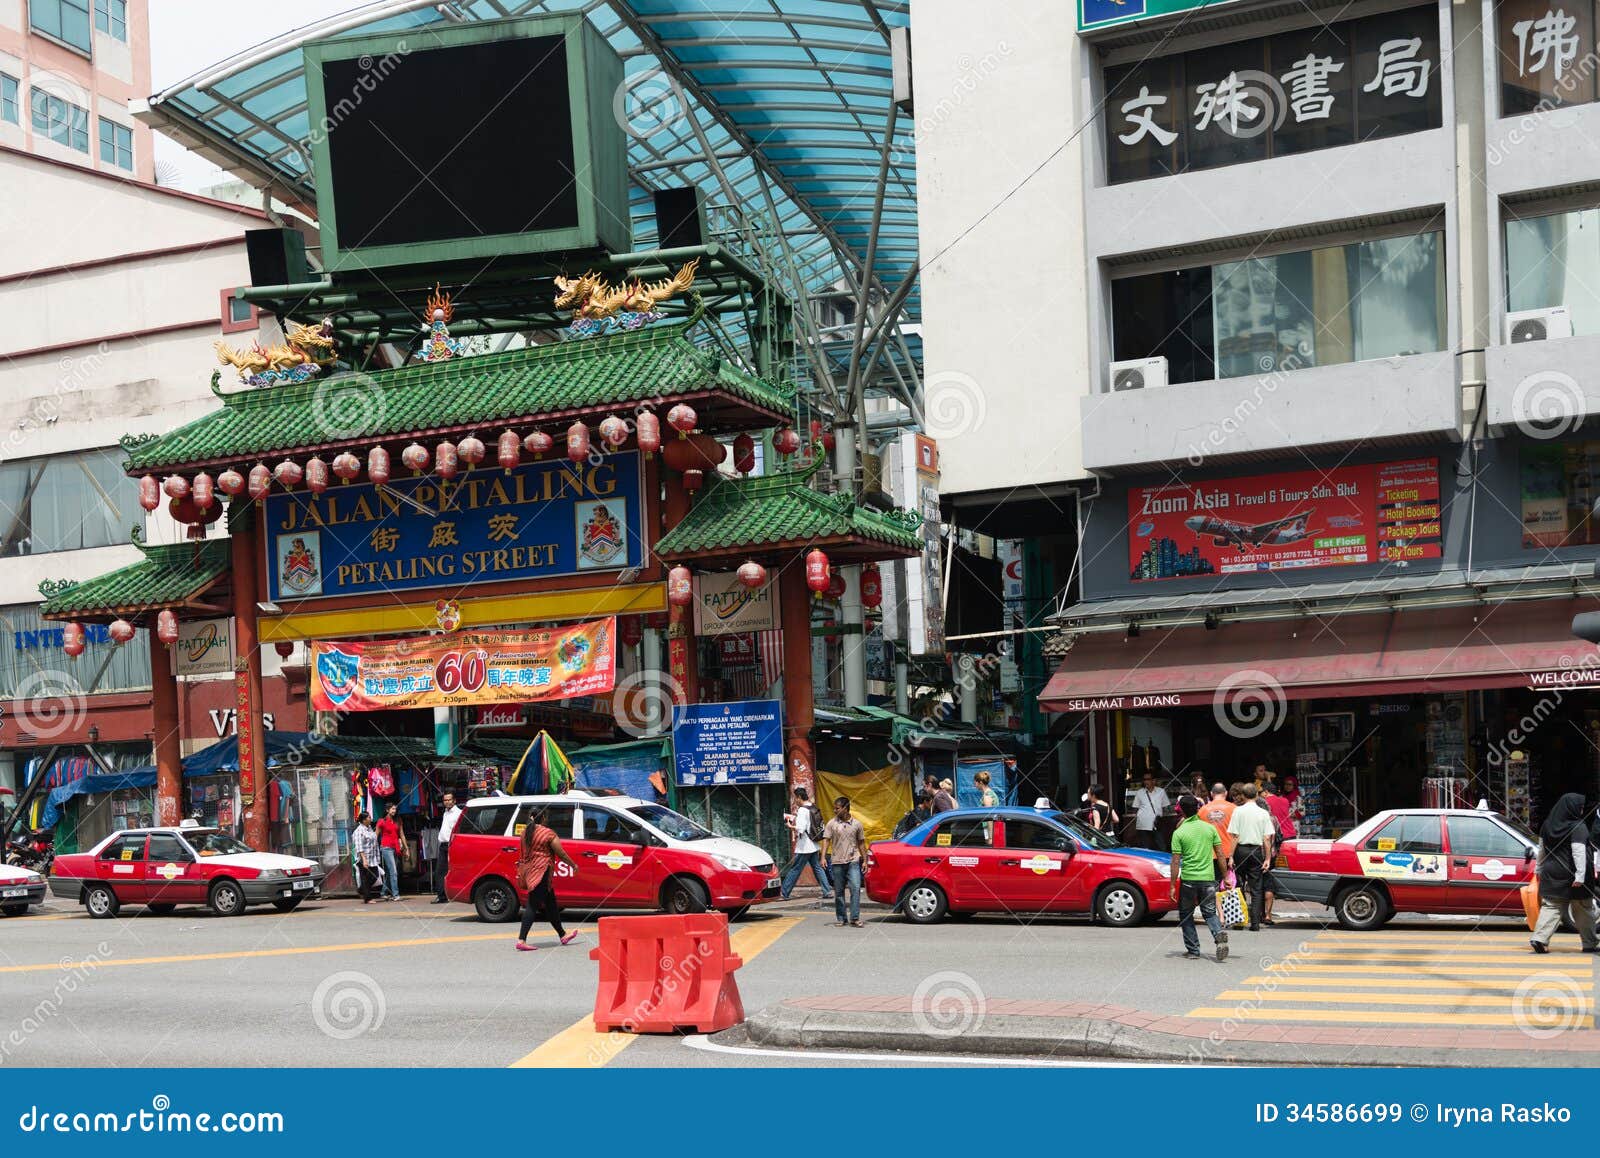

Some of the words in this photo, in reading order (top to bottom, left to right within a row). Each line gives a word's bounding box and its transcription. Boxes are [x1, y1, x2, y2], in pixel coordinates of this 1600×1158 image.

[1511, 8, 1580, 81] 佛
[1117, 36, 1433, 149] 文殊書局
[281, 488, 402, 531] JALAN
[415, 463, 618, 517] PETALING
[1142, 494, 1188, 515] Zoom
[1193, 488, 1230, 510] Asia
[1235, 492, 1267, 507] Travel
[1280, 488, 1309, 502] Tours
[1312, 485, 1334, 499] Sdn.
[1337, 482, 1360, 497] Bhd.
[1386, 488, 1419, 501] Ticketing
[1386, 507, 1404, 518] Hotel
[1406, 504, 1437, 517] Booking
[1387, 525, 1417, 538] Package
[1419, 523, 1440, 535] Tours
[1318, 539, 1334, 548] 1st
[1336, 536, 1361, 546] Floor
[1387, 546, 1402, 559] City
[1403, 545, 1424, 557] Tours
[338, 552, 456, 587] PETALING
[462, 543, 560, 575] STREET
[487, 667, 552, 688] 周年晚宴
[1530, 669, 1600, 685] WELCOME
[1068, 697, 1126, 711] SELAMAT
[1133, 694, 1182, 708] DATANG
[1379, 704, 1411, 713] SEIKO
[483, 711, 518, 725] Hotel
